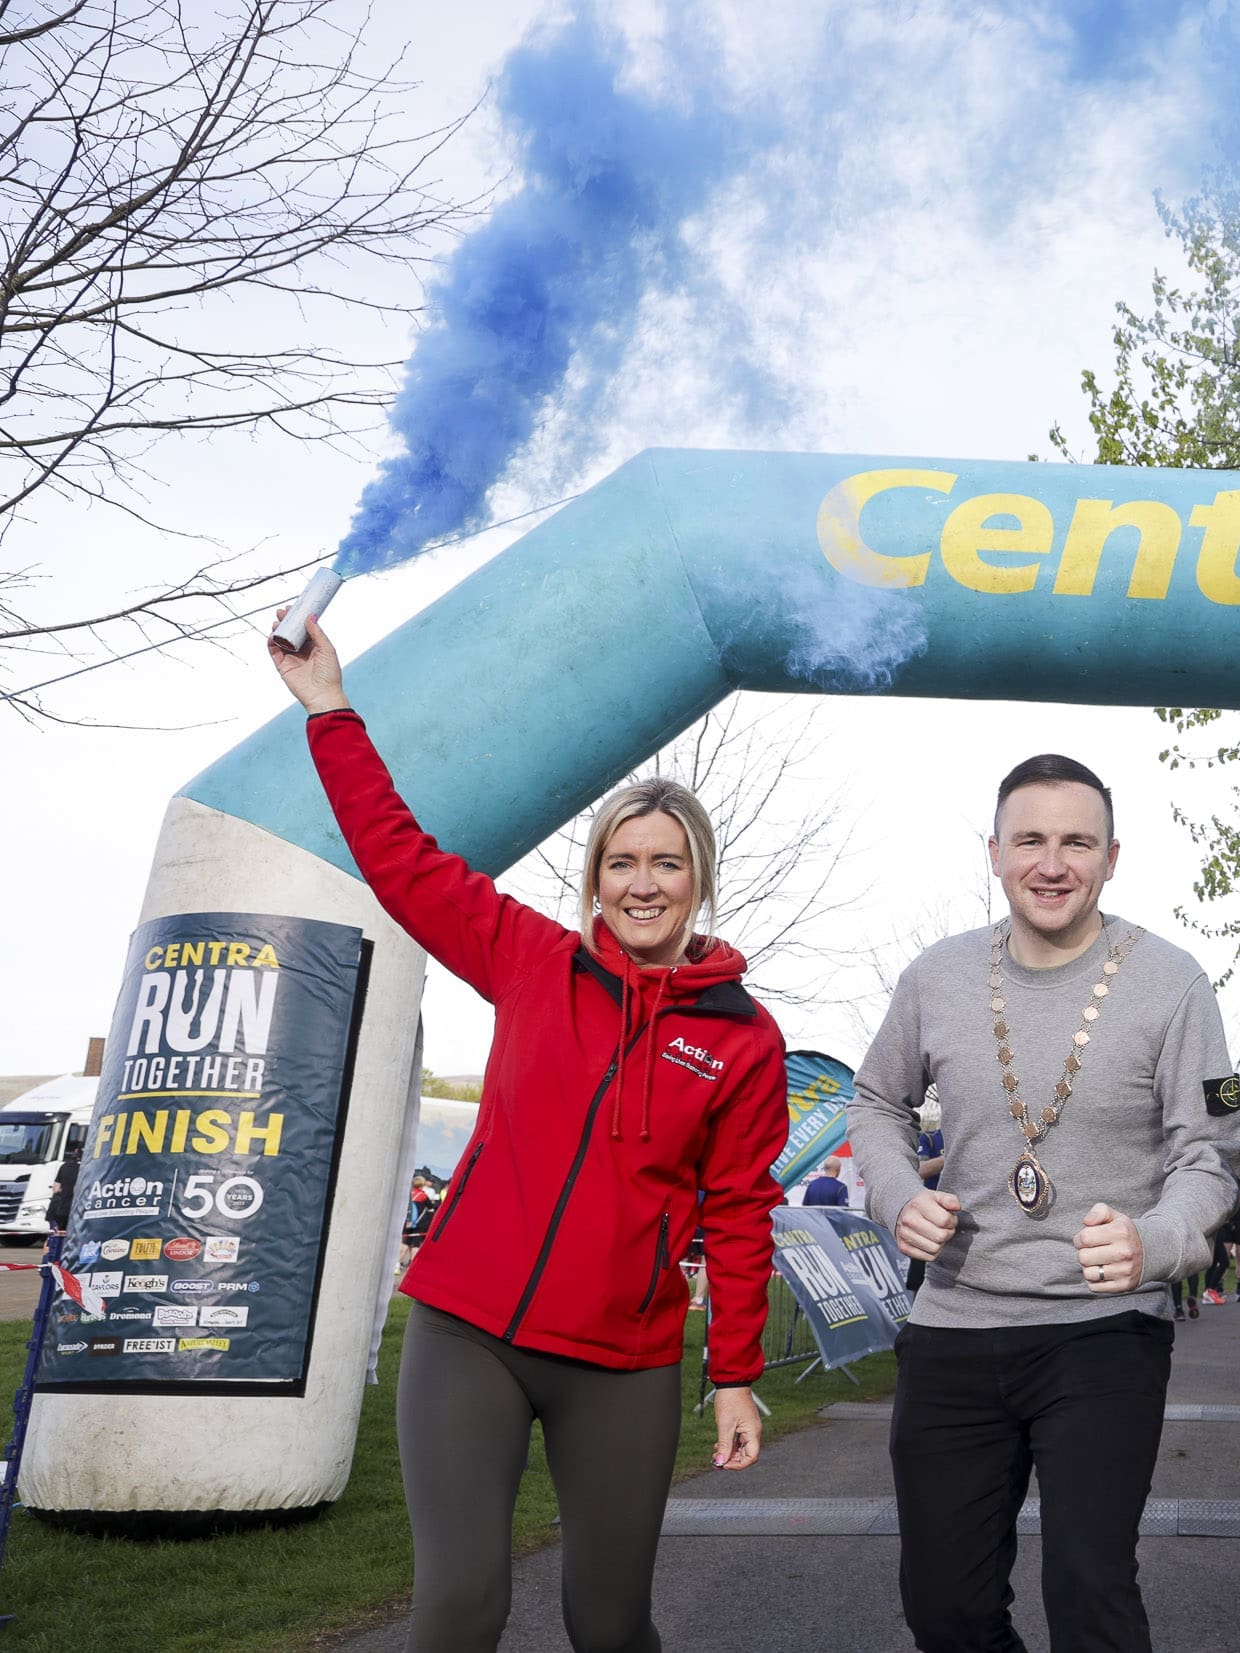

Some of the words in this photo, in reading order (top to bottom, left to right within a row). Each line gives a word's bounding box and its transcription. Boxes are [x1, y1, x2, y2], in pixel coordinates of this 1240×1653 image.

[144, 941, 281, 971] CENTRA
[126, 968, 280, 1057] RUN
[120, 1056, 266, 1093] TOGETHER
[93, 1109, 285, 1159] FINISH
[788, 1107, 829, 1150] EVERY
[84, 1195, 162, 1211] cancer
[180, 1175, 264, 1220] 50
[127, 1277, 166, 1290] Keogh's
[173, 1282, 211, 1290] BOOST
[217, 1282, 248, 1291] PRM
[781, 1244, 853, 1302] RUN
[850, 1244, 905, 1300] UN
